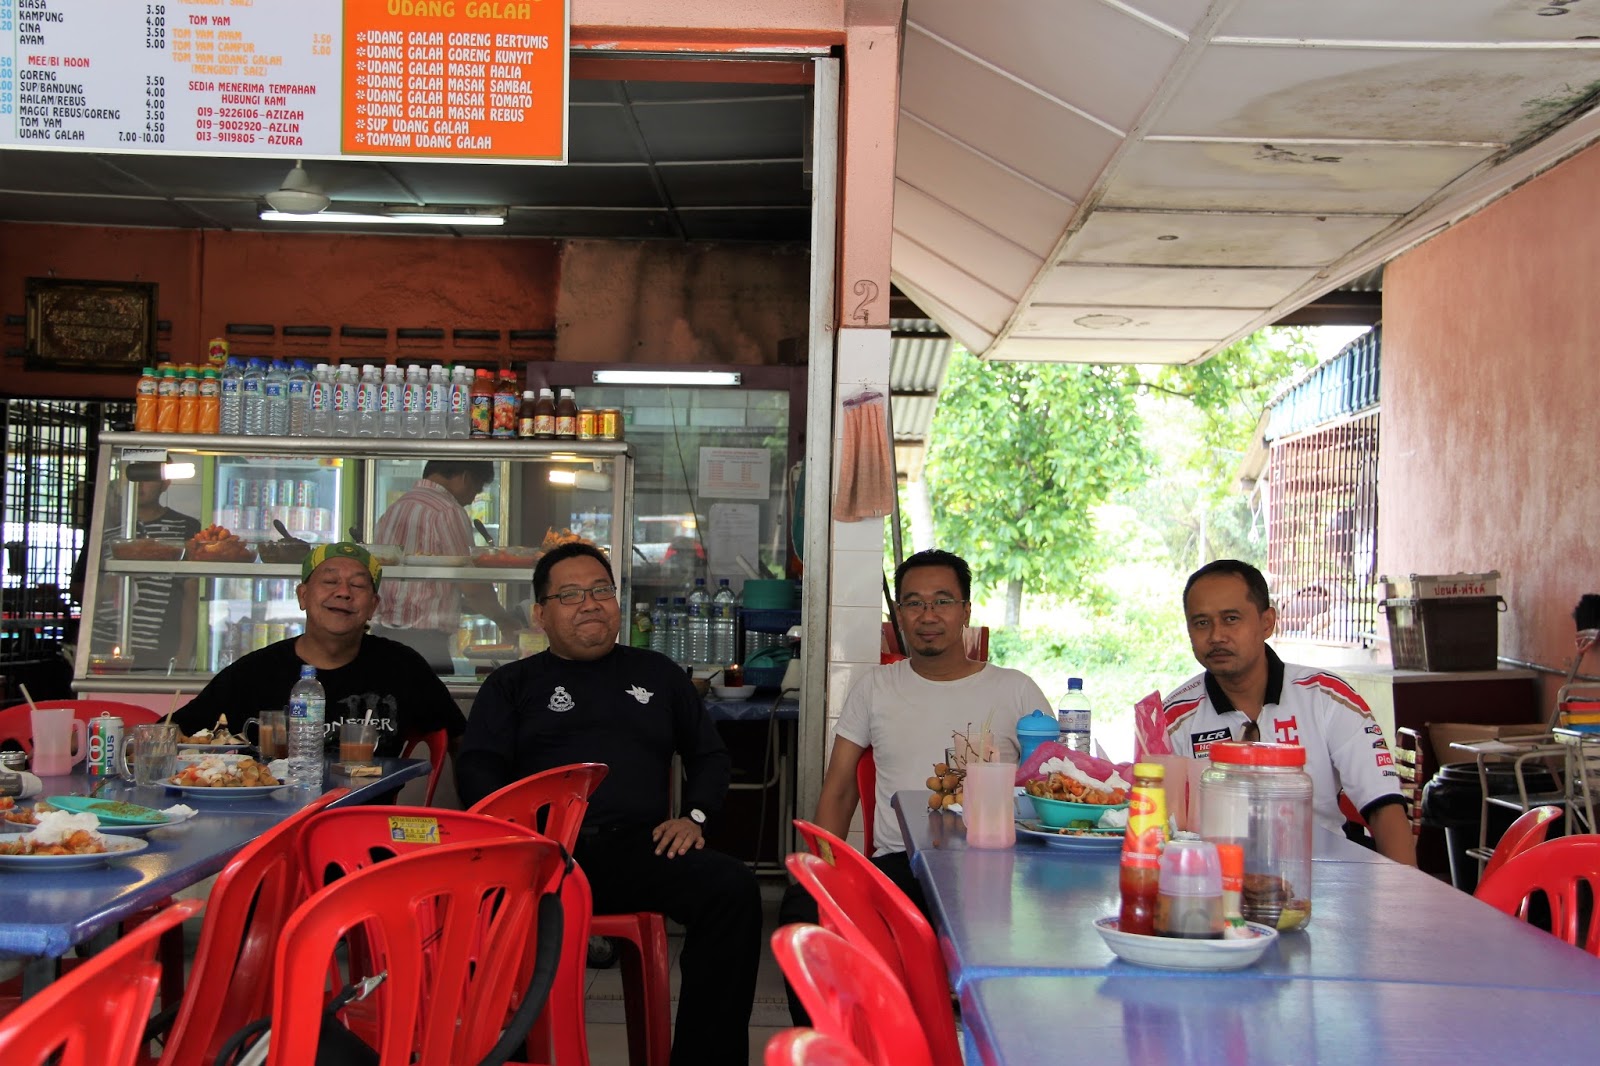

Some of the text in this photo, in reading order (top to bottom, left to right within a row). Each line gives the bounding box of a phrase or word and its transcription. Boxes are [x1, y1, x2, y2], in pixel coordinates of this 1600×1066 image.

[19, 0, 46, 9] BIASA
[146, 5, 165, 15] 3.50
[388, 1, 531, 20] UDANG GALAH
[19, 11, 63, 22] KAMPUNG
[146, 17, 165, 26] 4.00
[189, 15, 230, 25] TOM YAM
[20, 23, 40, 33] CINA
[146, 28, 165, 37] 3.50
[20, 35, 44, 45] AYAM
[173, 29, 242, 40] TOM YAM AYAM
[313, 34, 331, 44] 3.50
[367, 31, 549, 49] UDANG GALAH GORENG BERTUMIS
[146, 39, 165, 48] 5.00
[173, 41, 254, 52] TOM YAM CAMPUR
[313, 46, 331, 55] 5.00
[367, 46, 533, 64] UDANG GALAH GORENG KUNYIT
[28, 56, 90, 67] MEE/BI HOON
[173, 52, 282, 65] TOM YAM UDANG GALAH
[20, 70, 56, 81] GORENG
[367, 60, 521, 79] UDANG GALAH MASAK HALIA
[146, 76, 164, 86] 3.50
[367, 75, 533, 94] UDANG GALAH MASAK SAMBAL
[20, 82, 83, 94] SUP/BANDUNG
[146, 88, 165, 97] 4.00
[189, 81, 316, 94] SEDIA MENERIMA TEMPAHAN
[20, 94, 86, 106] HAILAM/REBUS
[146, 99, 165, 109] 4.00
[222, 95, 286, 106] HUBUNGI KAMI
[367, 90, 533, 108] UDANG GALAH MASAK TOMATO
[20, 106, 120, 119] MAGGI REBUS/GORENG
[146, 111, 165, 120] 3.50
[367, 104, 524, 122] UDANG GALAH MASAK REBUS
[20, 117, 62, 128] TOM YAM
[146, 122, 165, 132] 4.50
[367, 118, 469, 134] SUP UDANG GALAH
[20, 129, 84, 140] UDANG GALAH
[196, 132, 255, 143] 013-9119805
[268, 135, 303, 146] AZURA
[366, 132, 492, 150] TOMYAM UDANG GALAH
[852, 279, 880, 321] 2
[312, 389, 322, 407] 100
[334, 390, 343, 408] 100
[357, 390, 366, 408] 100
[381, 391, 389, 408] 100
[403, 391, 412, 408] 100
[425, 391, 433, 408] 100
[452, 392, 462, 410] 100
[1198, 730, 1226, 742] LCR
[89, 735, 104, 768] 100
